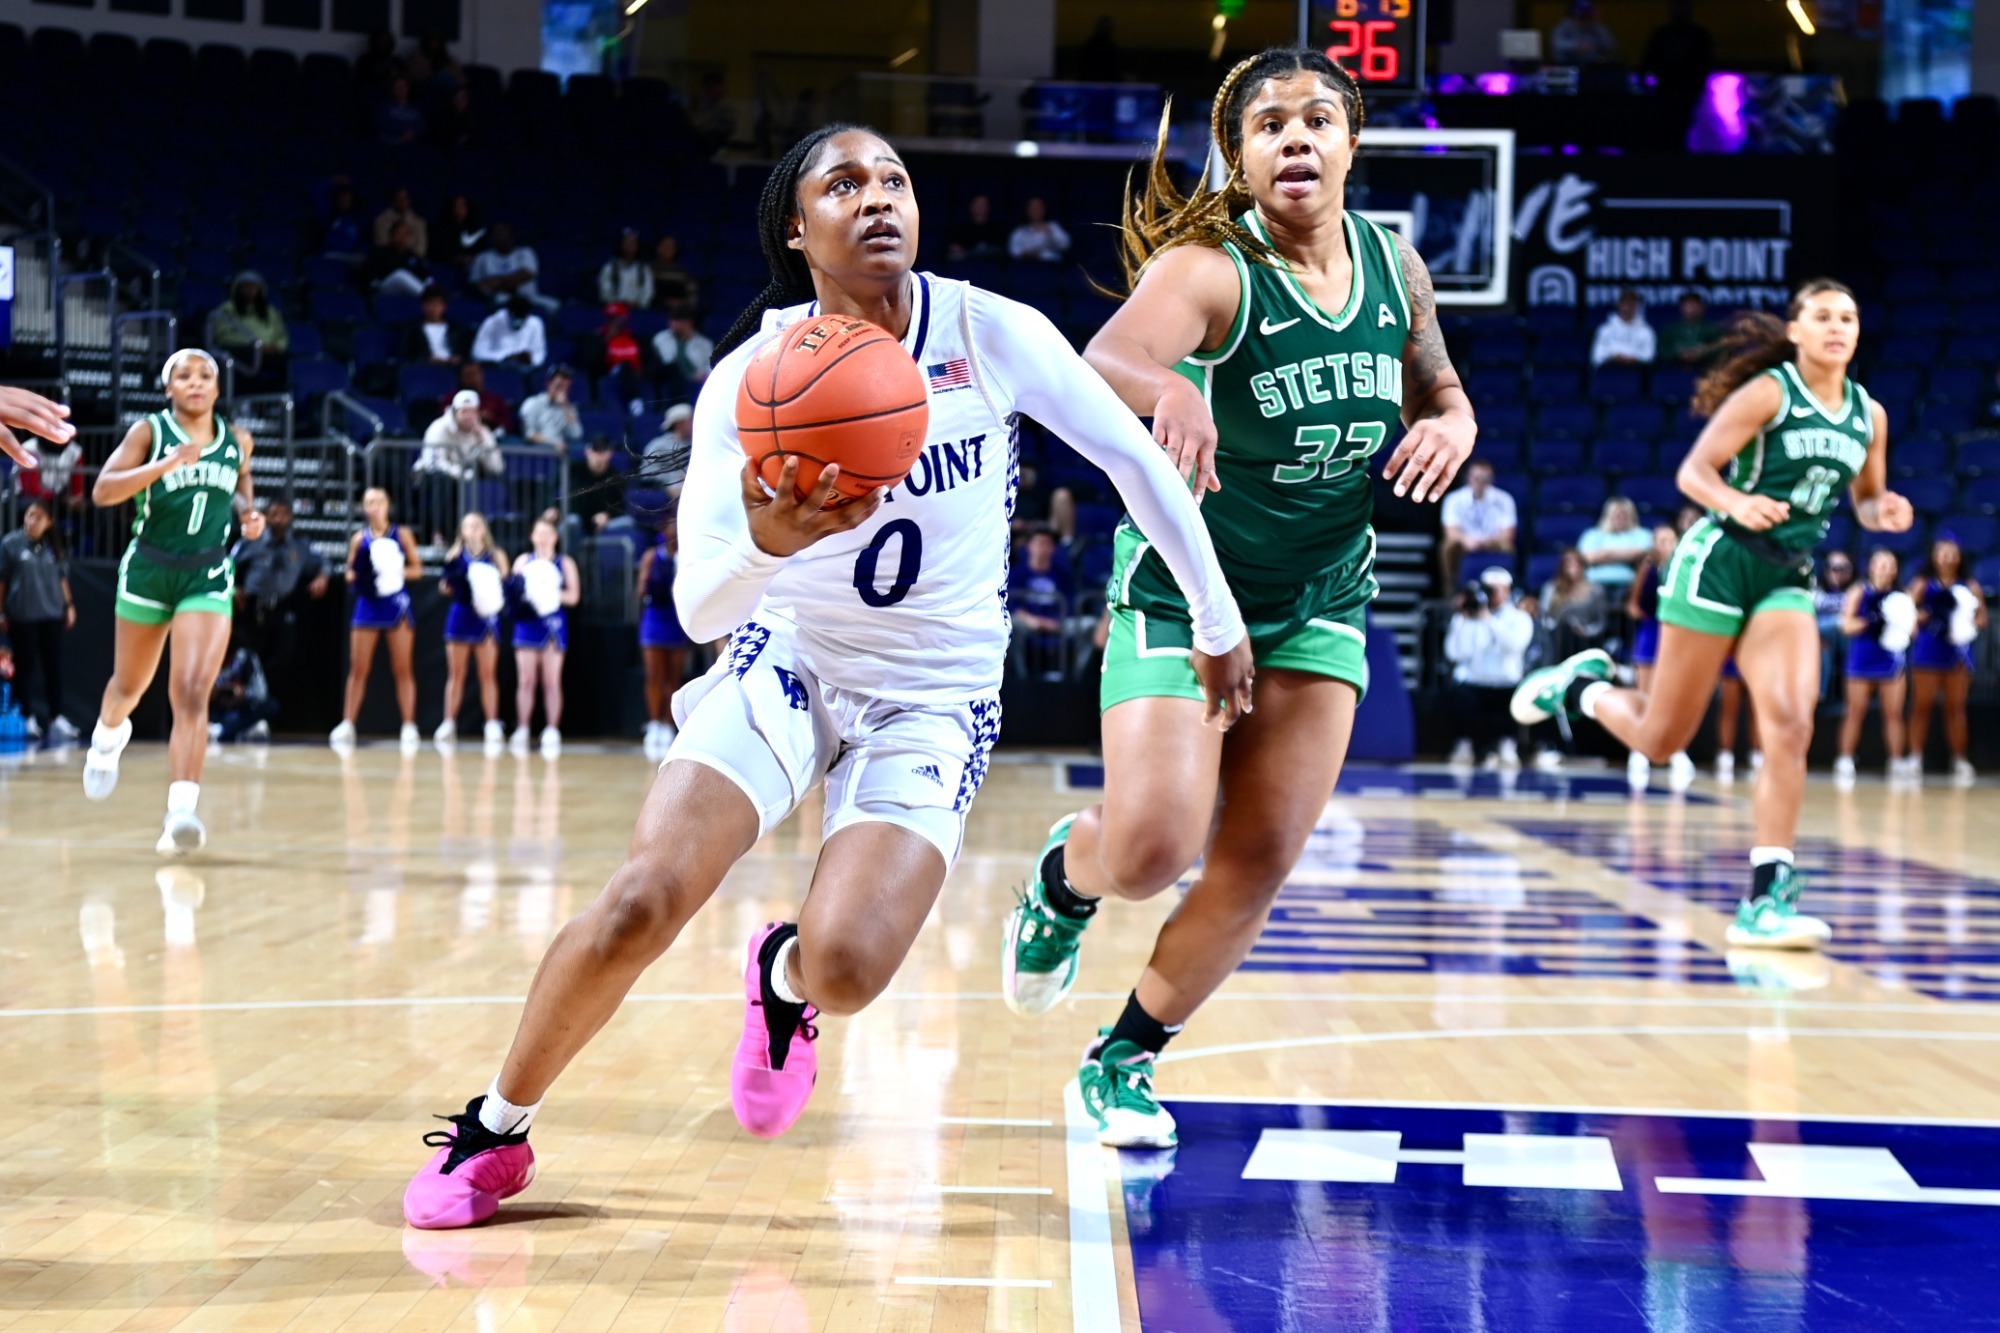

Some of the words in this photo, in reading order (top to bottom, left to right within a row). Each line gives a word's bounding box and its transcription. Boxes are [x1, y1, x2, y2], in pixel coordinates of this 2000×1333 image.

[1325, 20, 1399, 81] 26
[1585, 236, 1672, 280] HIGH
[1682, 236, 1791, 281] POINT
[884, 433, 987, 503] OINT
[186, 491, 209, 535] 1
[853, 518, 922, 607] 0
[911, 768, 944, 787] adidas
